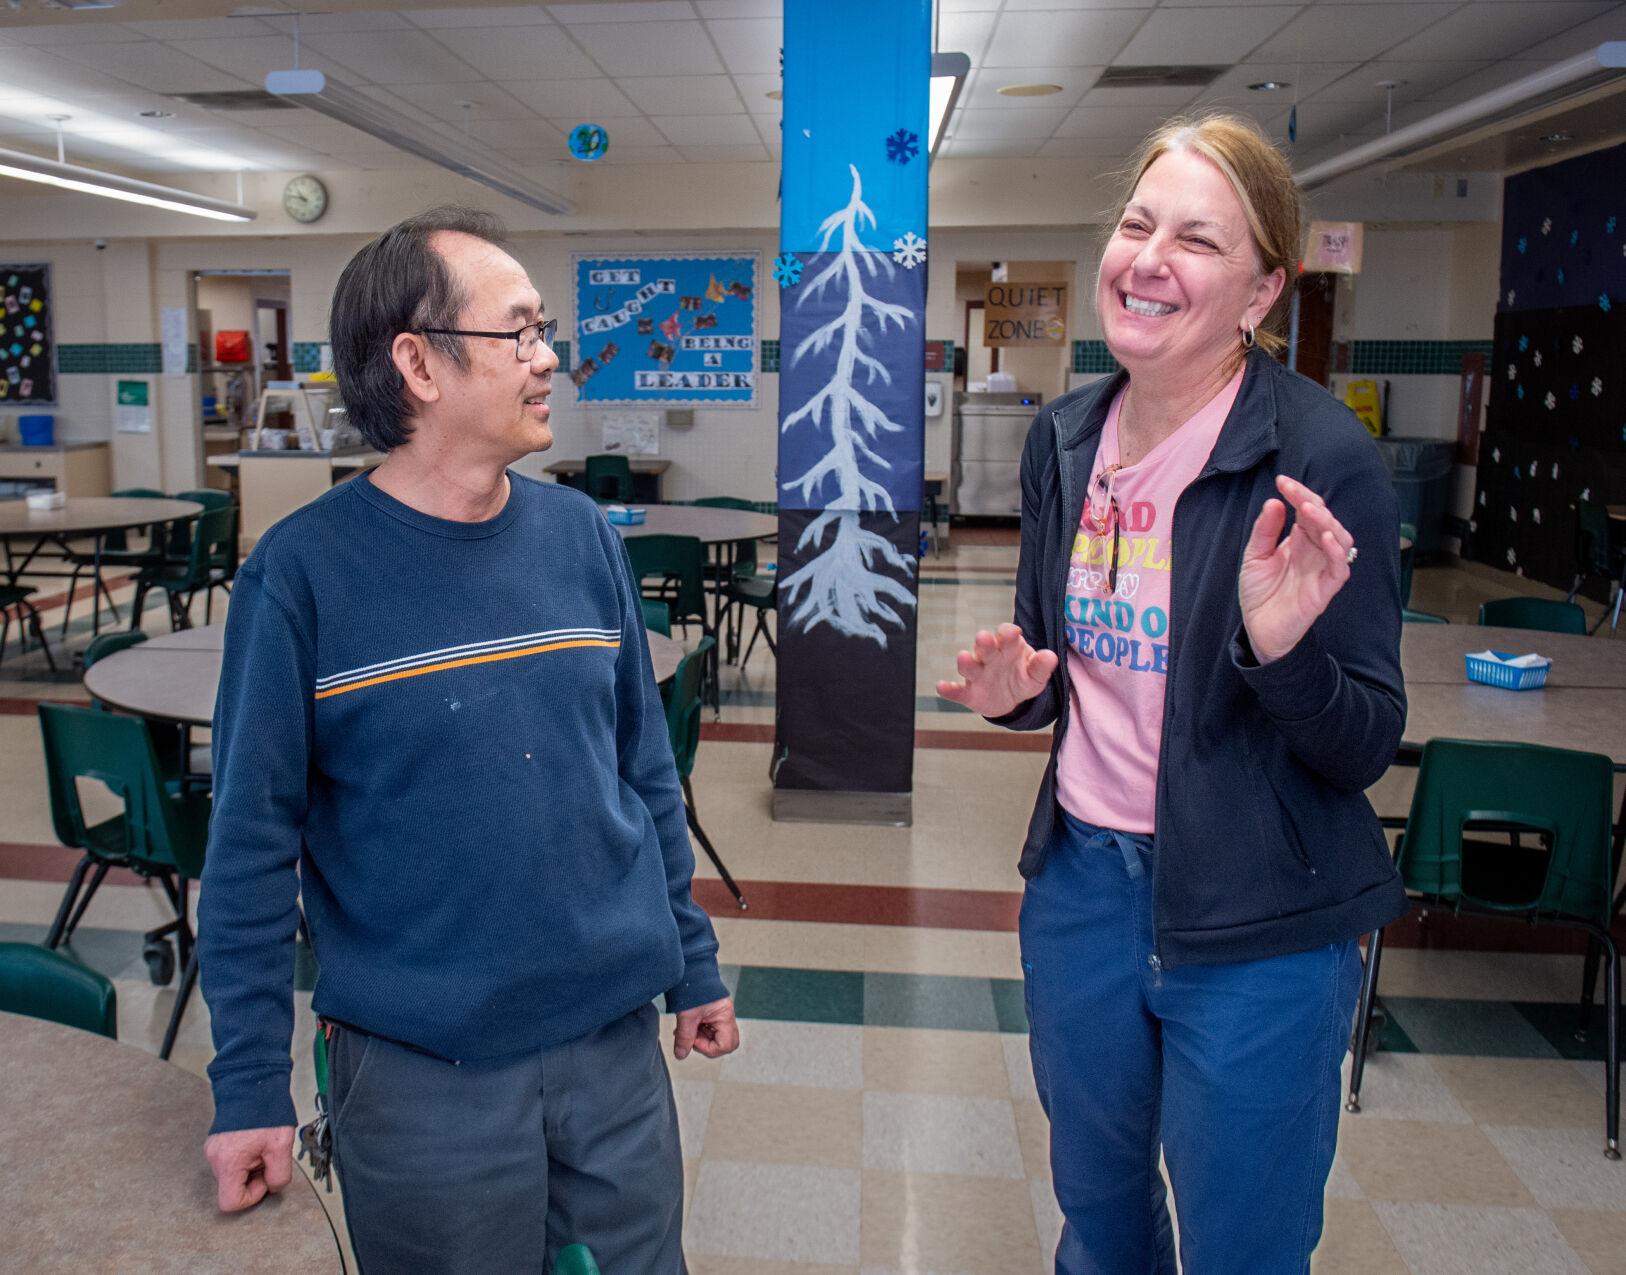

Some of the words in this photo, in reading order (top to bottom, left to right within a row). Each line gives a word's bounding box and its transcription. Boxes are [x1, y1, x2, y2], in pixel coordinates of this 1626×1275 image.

[591, 270, 639, 283] GET
[583, 280, 674, 333] CAUGHT
[988, 320, 1045, 339] ZONE
[684, 337, 751, 349] BEING
[705, 354, 719, 365] A
[638, 373, 752, 388] LEADER
[1070, 533, 1172, 571] PEOPL
[1141, 606, 1168, 639] O
